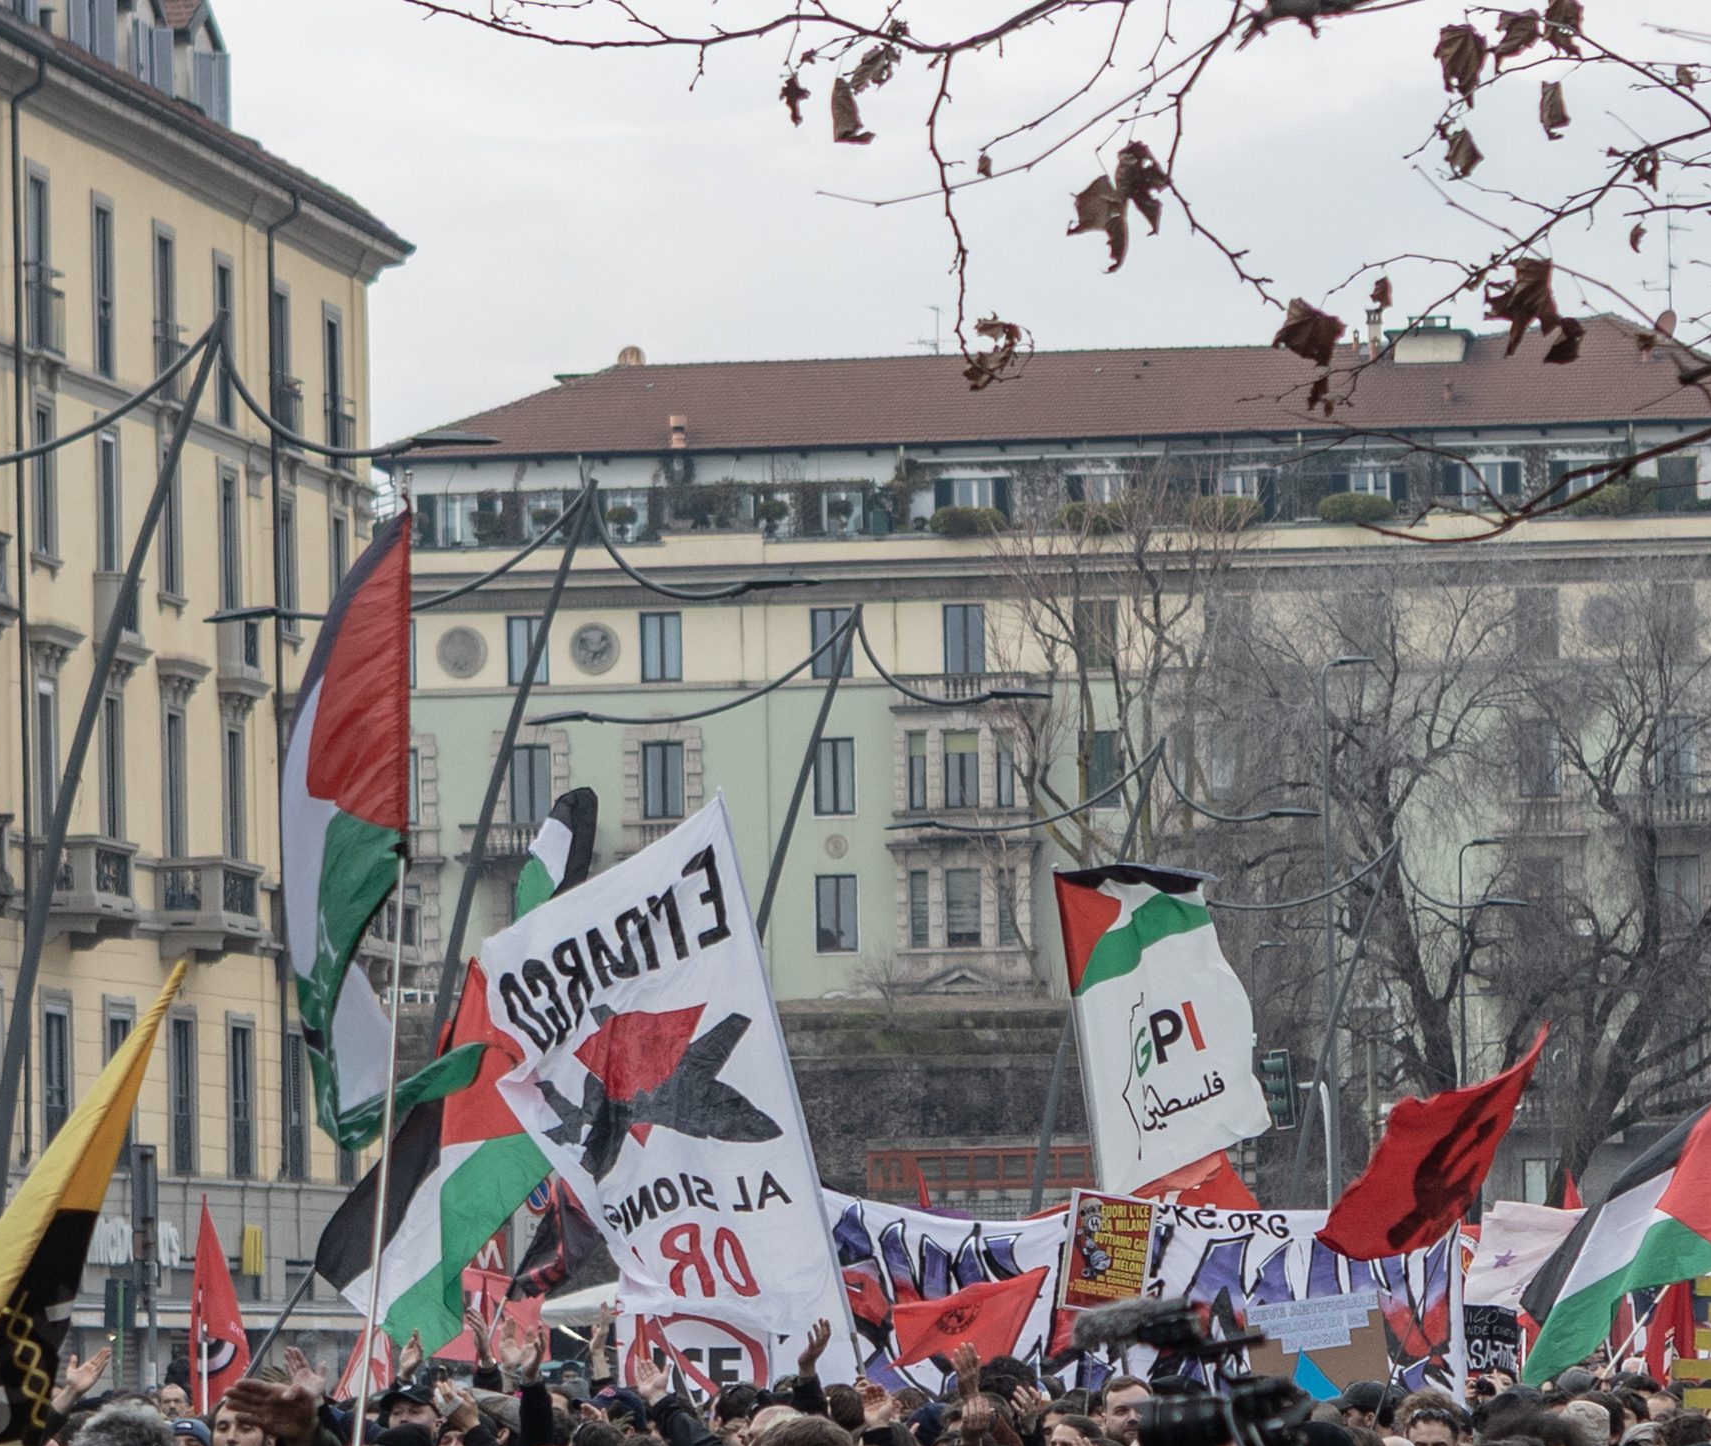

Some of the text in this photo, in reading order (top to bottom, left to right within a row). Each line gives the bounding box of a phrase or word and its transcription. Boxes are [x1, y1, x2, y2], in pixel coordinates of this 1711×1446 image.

[1135, 1000, 1207, 1078] GPI
[1142, 1071, 1226, 1132] فلسطين
[1101, 1204, 1150, 1218] FUORI L'ICE
[1101, 1220, 1149, 1232] DA MILANO
